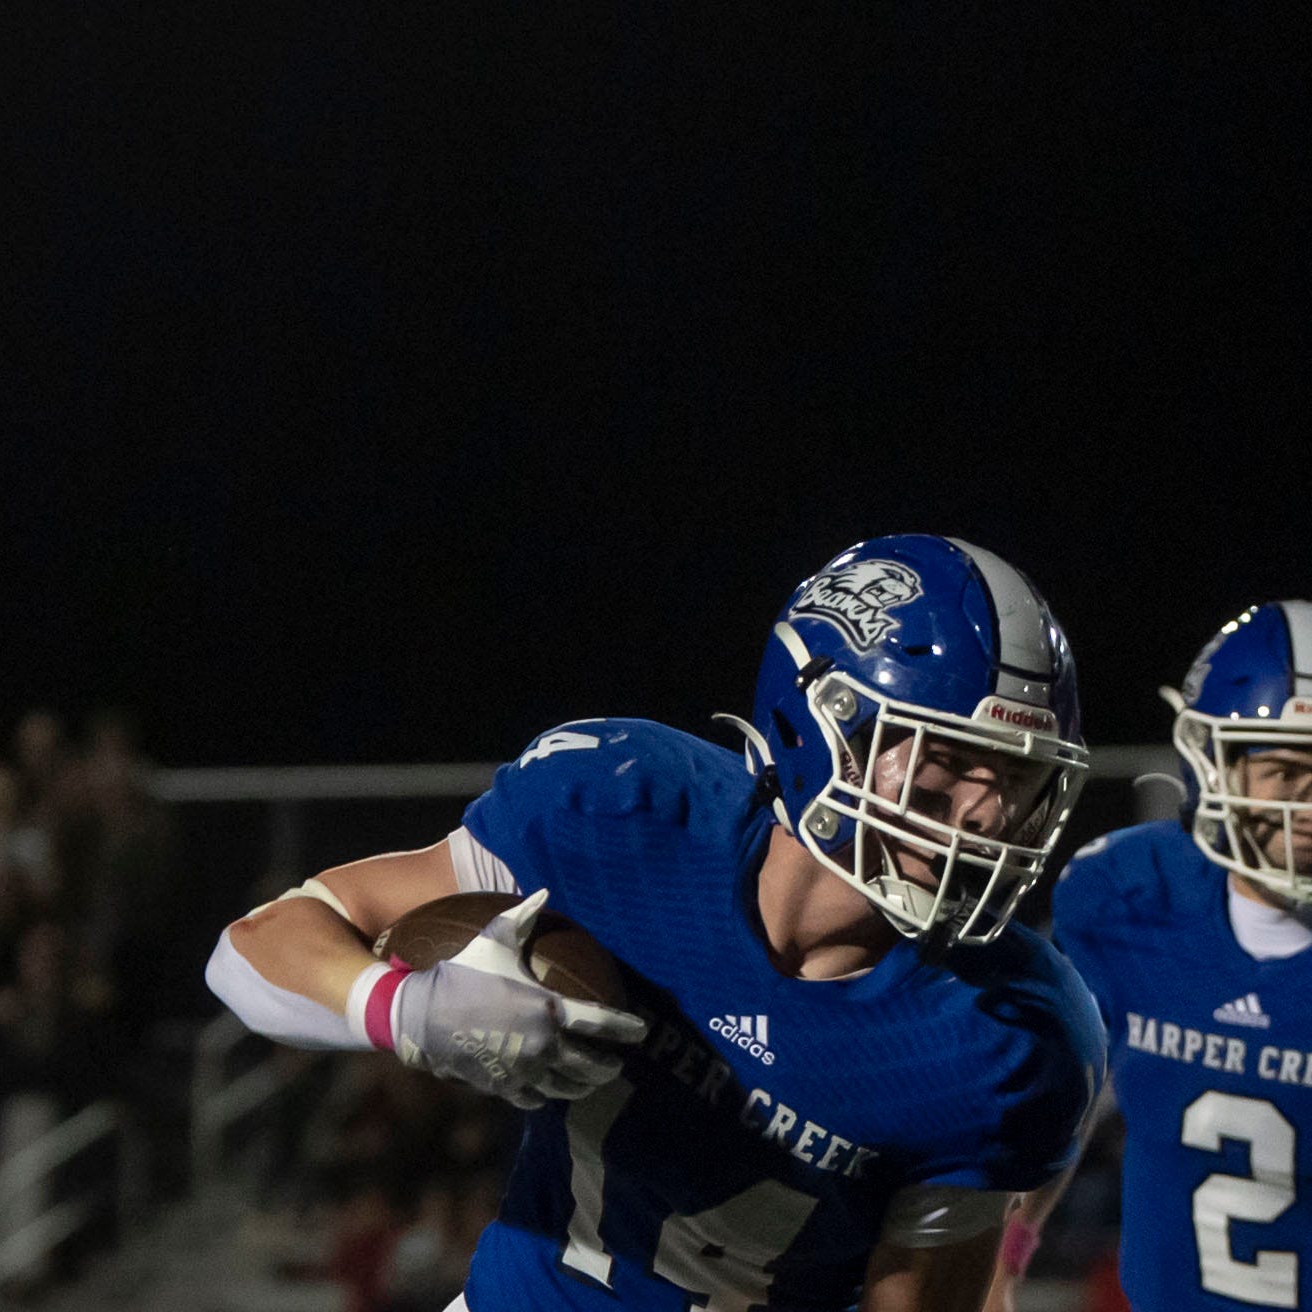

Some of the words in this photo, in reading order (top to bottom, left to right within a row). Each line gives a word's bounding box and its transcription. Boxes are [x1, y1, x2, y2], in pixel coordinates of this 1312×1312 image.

[793, 575, 889, 643] Beavers
[450, 1030, 508, 1079] adida
[709, 1017, 775, 1065] adidas
[1126, 1012, 1247, 1074] HARPER
[742, 1087, 880, 1179] CREEK
[1181, 1090, 1298, 1310] 2
